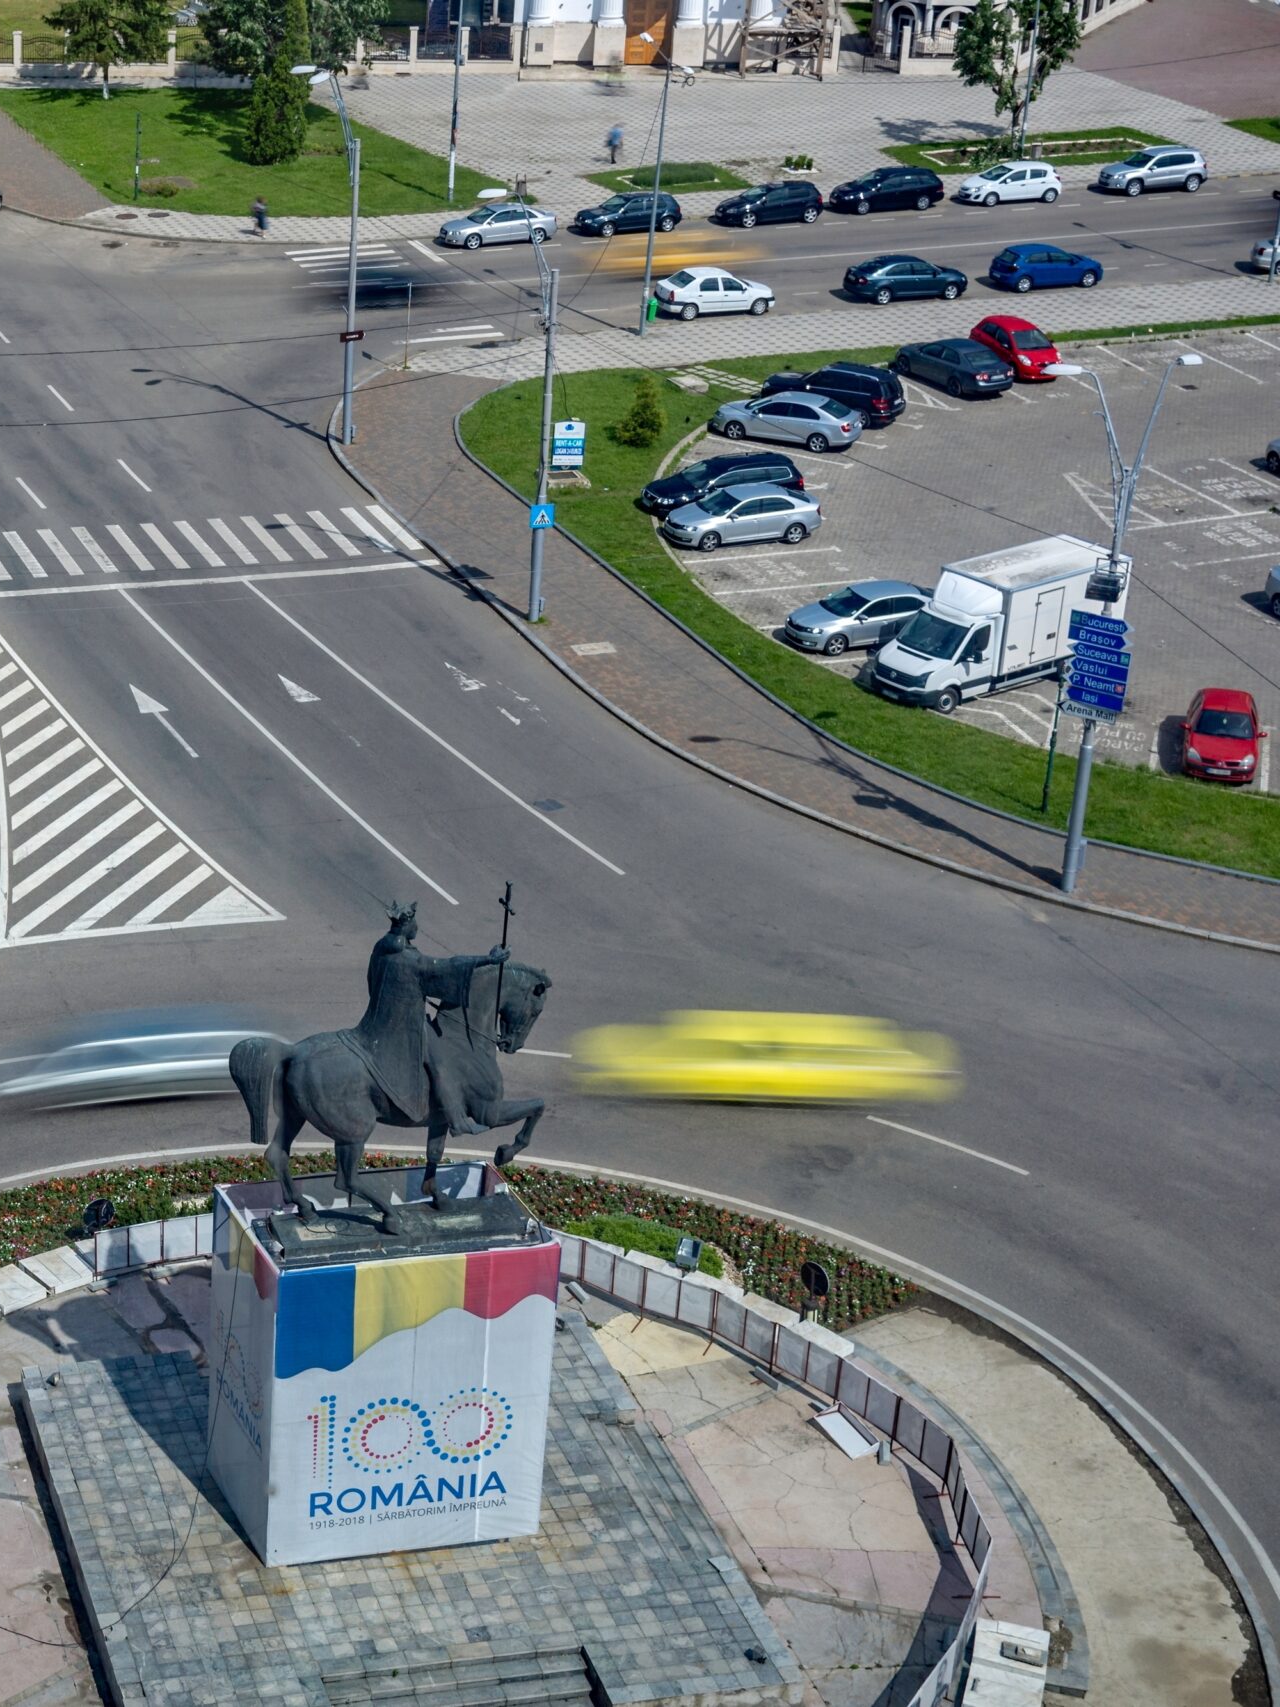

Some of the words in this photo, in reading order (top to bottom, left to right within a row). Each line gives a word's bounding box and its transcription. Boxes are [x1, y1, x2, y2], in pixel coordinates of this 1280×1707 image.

[1077, 645, 1118, 662] Suceava
[1075, 659, 1108, 675] Vaslui
[1066, 703, 1093, 716] Arena
[1095, 709, 1114, 721] Mall
[306, 1387, 513, 1490] 100
[309, 1470, 507, 1518] ROMÂNIA
[309, 1515, 366, 1530] 1918-2018
[377, 1505, 446, 1522] SĂRBĂTORIM
[449, 1497, 507, 1513] ÎMPREUNĂ
